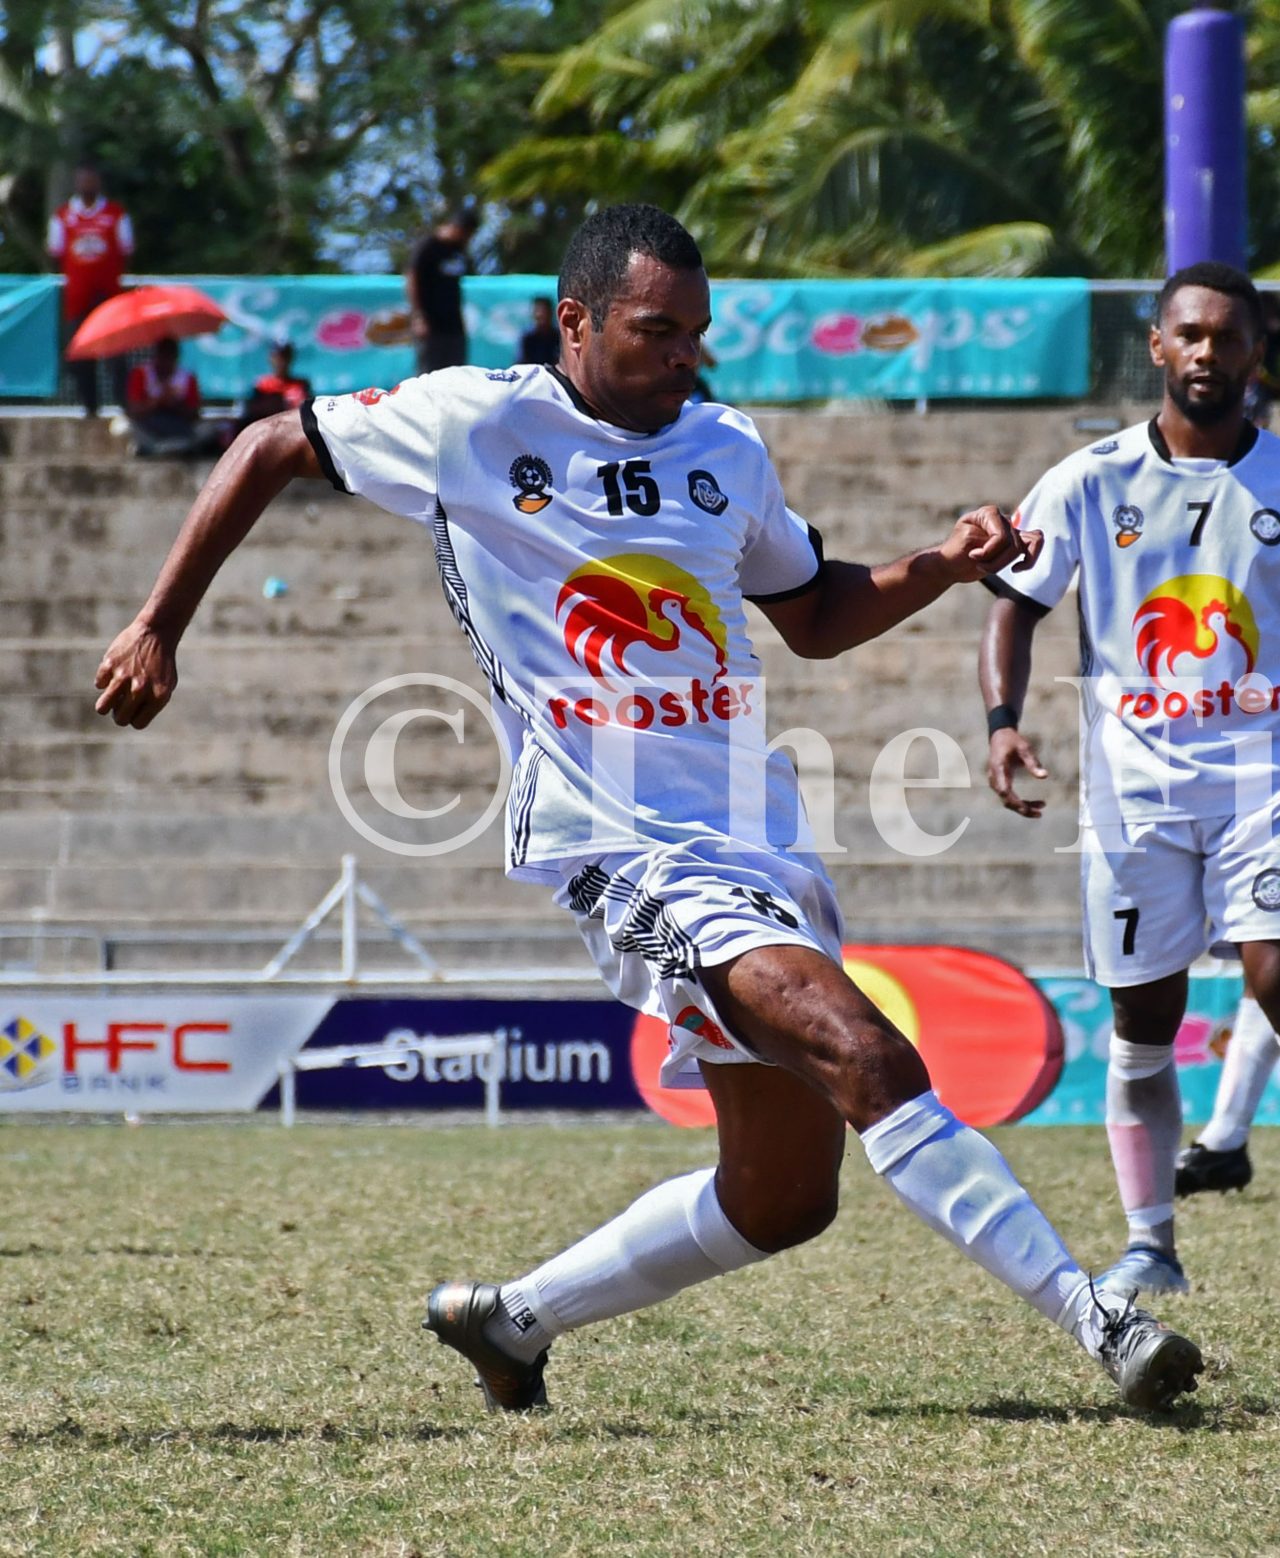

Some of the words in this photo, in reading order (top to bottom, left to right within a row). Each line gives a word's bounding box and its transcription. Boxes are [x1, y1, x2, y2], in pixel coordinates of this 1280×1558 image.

[597, 460, 661, 516] 15
[1187, 501, 1213, 547] 7
[547, 678, 754, 730] rooster
[1113, 907, 1140, 955] 7
[62, 1021, 232, 1074] HFC
[383, 1027, 611, 1082] Stadium
[62, 1075, 165, 1090] BANK
